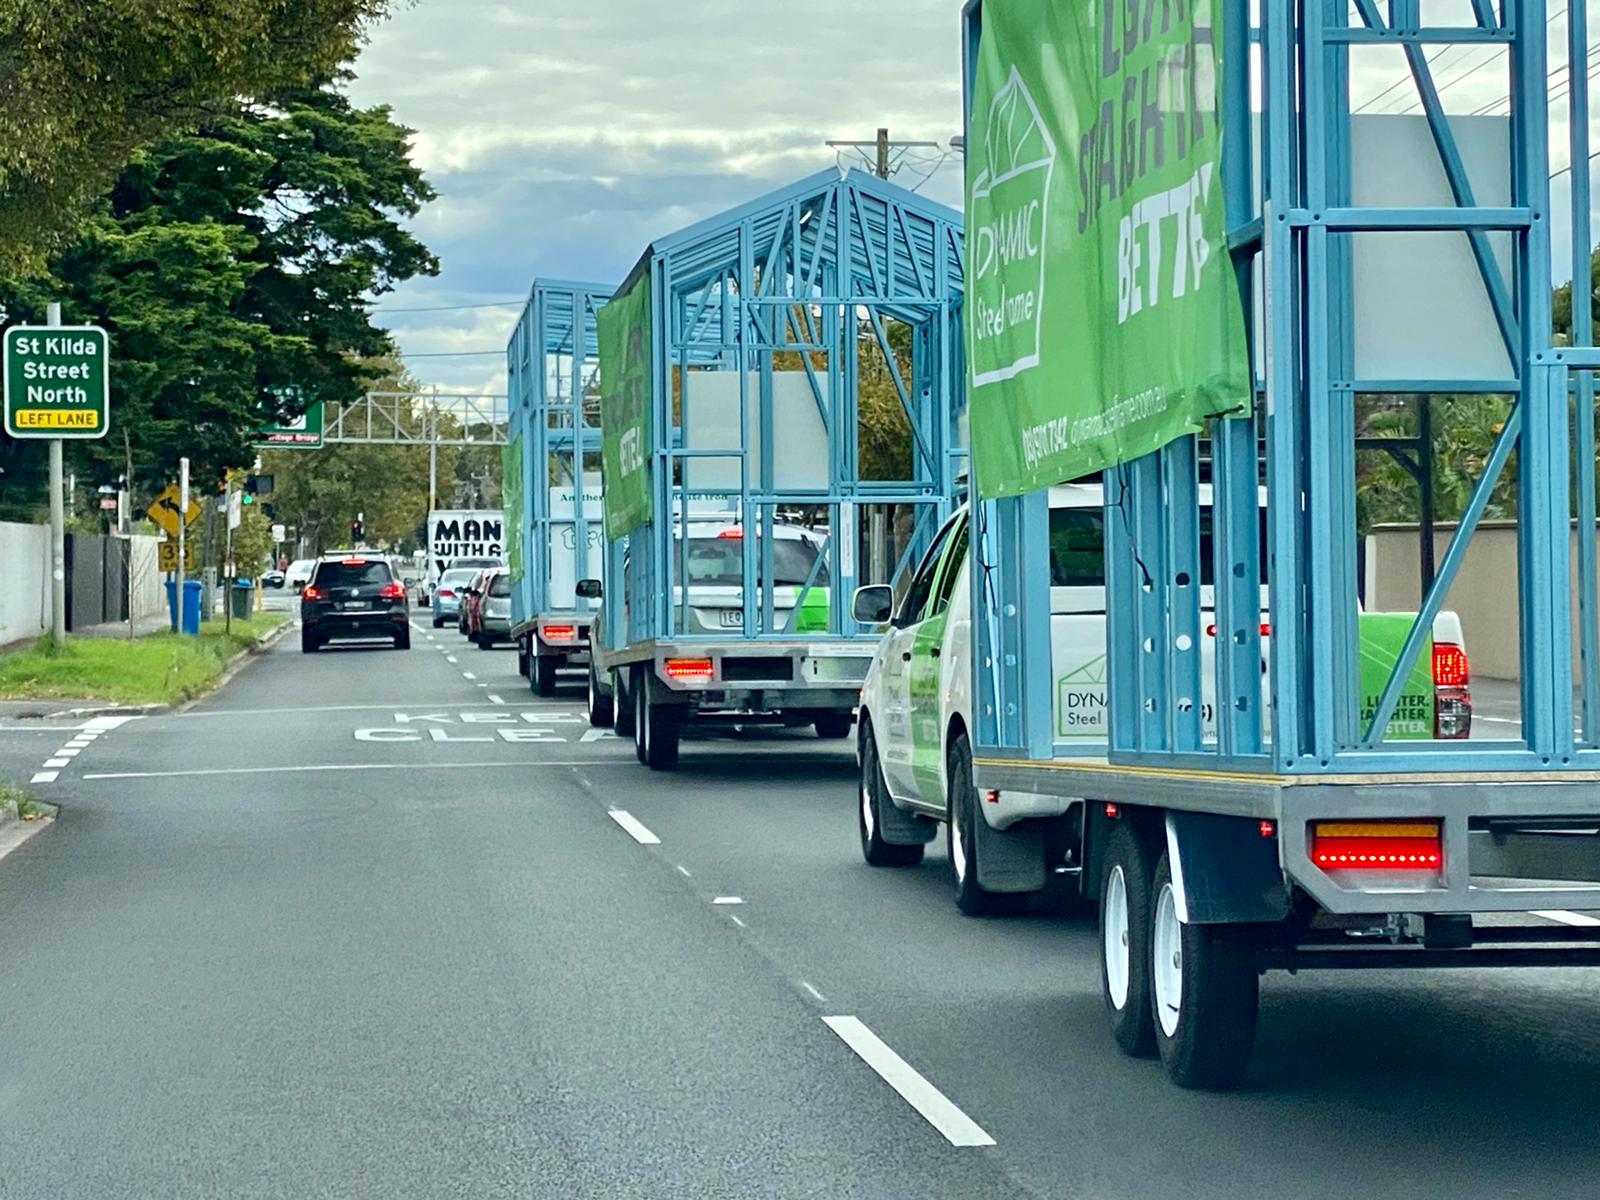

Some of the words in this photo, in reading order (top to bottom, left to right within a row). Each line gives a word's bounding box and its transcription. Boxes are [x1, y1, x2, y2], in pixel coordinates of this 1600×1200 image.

[16, 337, 40, 355] St
[45, 337, 97, 355] Kilda
[23, 361, 90, 379] Street
[27, 385, 87, 403] North
[20, 413, 52, 425] LEFT
[57, 413, 94, 425] LANE
[435, 520, 501, 541] MAN
[434, 543, 484, 557] WITH
[488, 543, 501, 557] A
[393, 712, 591, 723] KEE
[1067, 711, 1101, 725] Steel
[354, 728, 620, 742] CLEA
